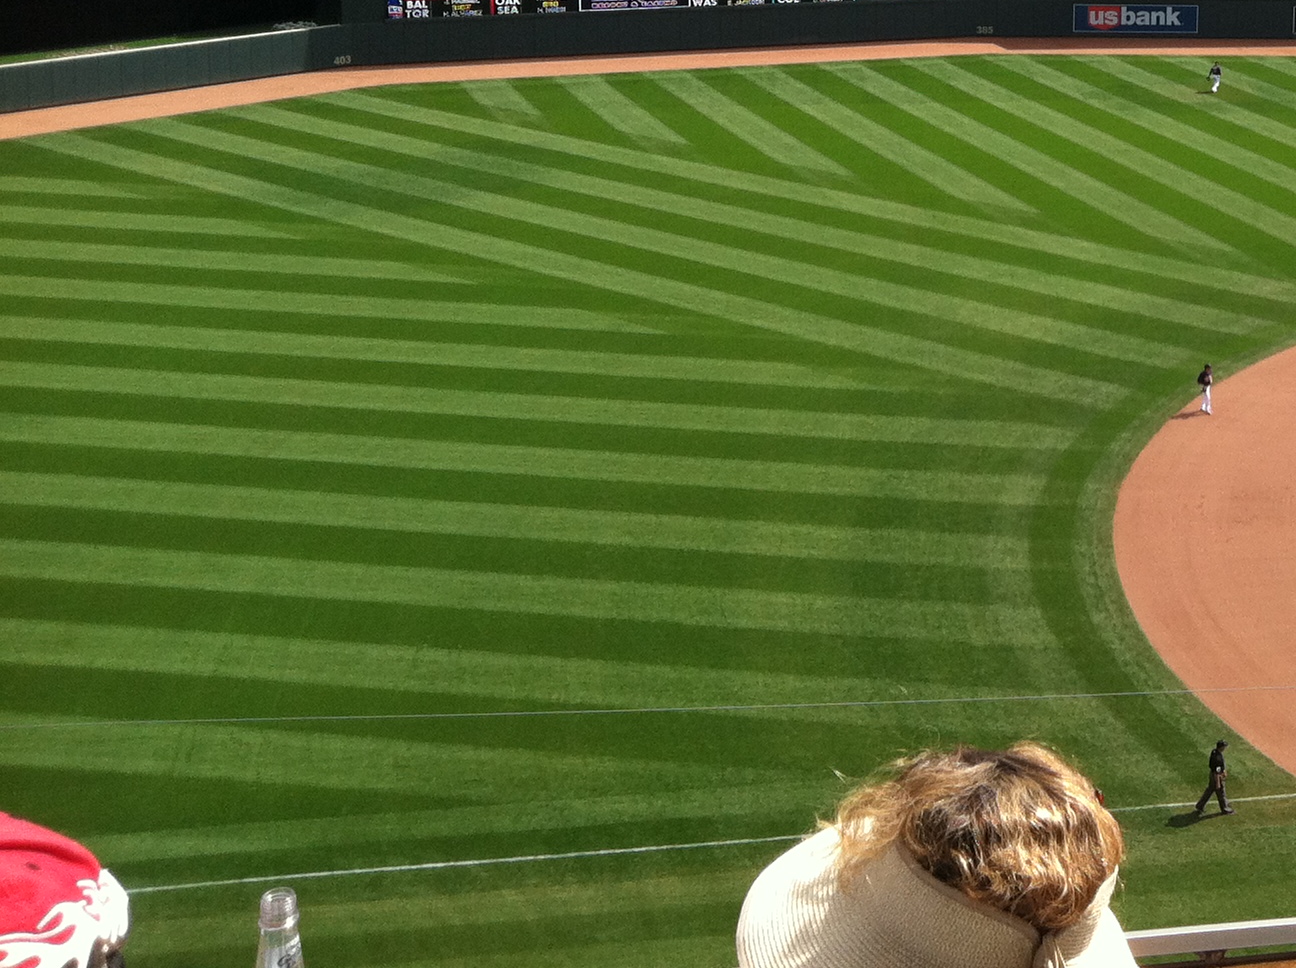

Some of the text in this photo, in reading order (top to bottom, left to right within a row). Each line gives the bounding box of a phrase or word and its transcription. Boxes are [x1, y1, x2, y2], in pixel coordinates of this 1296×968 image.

[406, 0, 428, 9] BAL
[405, 9, 429, 18] TOR
[497, 5, 519, 15] SEA
[333, 55, 351, 65] 403
